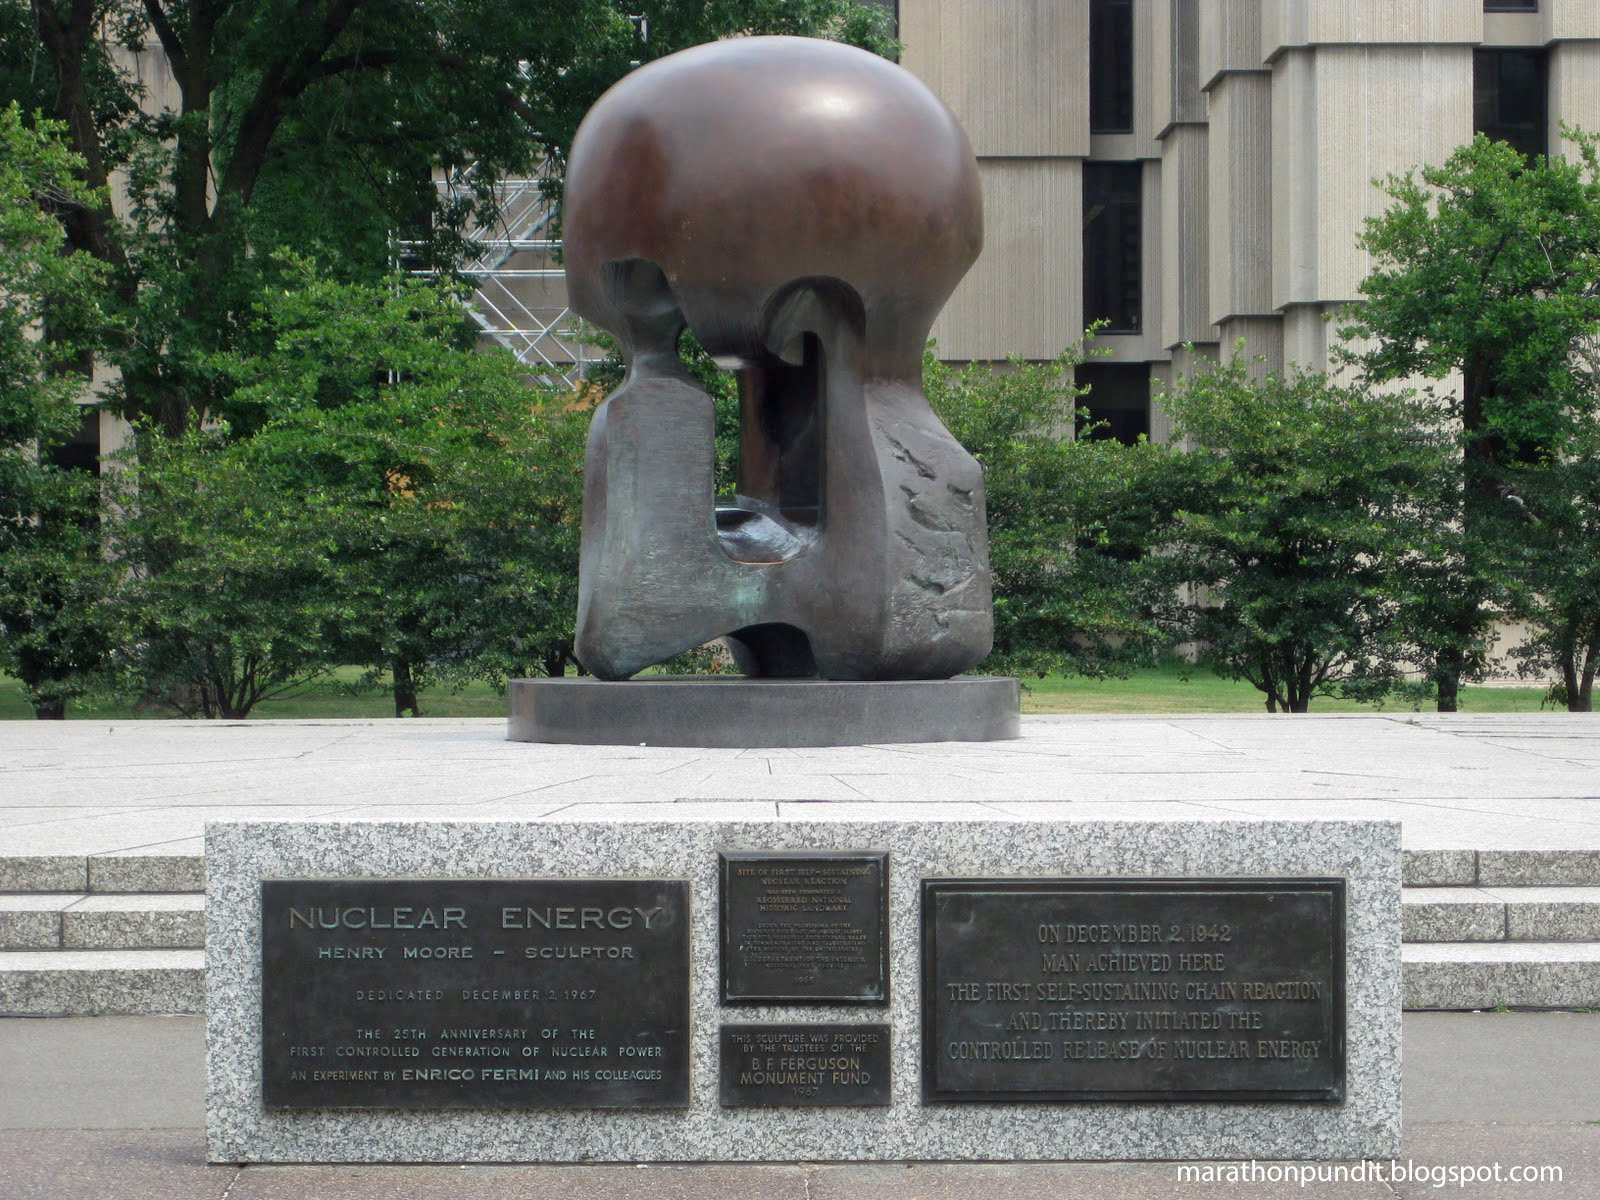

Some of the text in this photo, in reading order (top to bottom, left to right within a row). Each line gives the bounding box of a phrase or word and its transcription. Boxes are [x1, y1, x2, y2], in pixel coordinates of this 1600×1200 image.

[289, 907, 662, 930] NUCLEAR ENERGY
[1039, 924, 1060, 943] ON
[1067, 924, 1162, 943] DECEMBER
[1190, 924, 1232, 943] 1942
[318, 946, 387, 960] HENRY
[403, 946, 474, 960] MOORE
[525, 946, 634, 960] SCULPTOR
[1042, 954, 1225, 972] MAN ACHIEVED HERE
[356, 990, 443, 1000] DEDICATED
[462, 990, 539, 1000] DECEMBER
[564, 990, 597, 1000] 1967
[948, 982, 1322, 1001] THE FIRST SELF-SUSTAINING CHAIN REACTION
[1007, 1012, 1262, 1030] AND THEREBY INITIATED THE
[356, 1029, 595, 1040] THE 25TH ANNIVERSARY OF THE
[732, 1034, 879, 1043] THIS SCULPTURE WAS PROVIDED
[290, 1047, 662, 1057] FIRST CONTROLLED GENERATION OF NUCLEAR POWER
[744, 1044, 867, 1052] BY THE TRUSTEES OF THE
[950, 1041, 1322, 1059] CONTROLLED RELEASE OF NUCLEAR ENERGY
[780, 1058, 860, 1070] FERGUSON
[291, 1068, 662, 1082] AN EXPERIMENT BY ENRICO FERMI AND HIS COLLEAGUES
[740, 1072, 871, 1084] MONUMENT FUND
[793, 1087, 819, 1096] 1967
